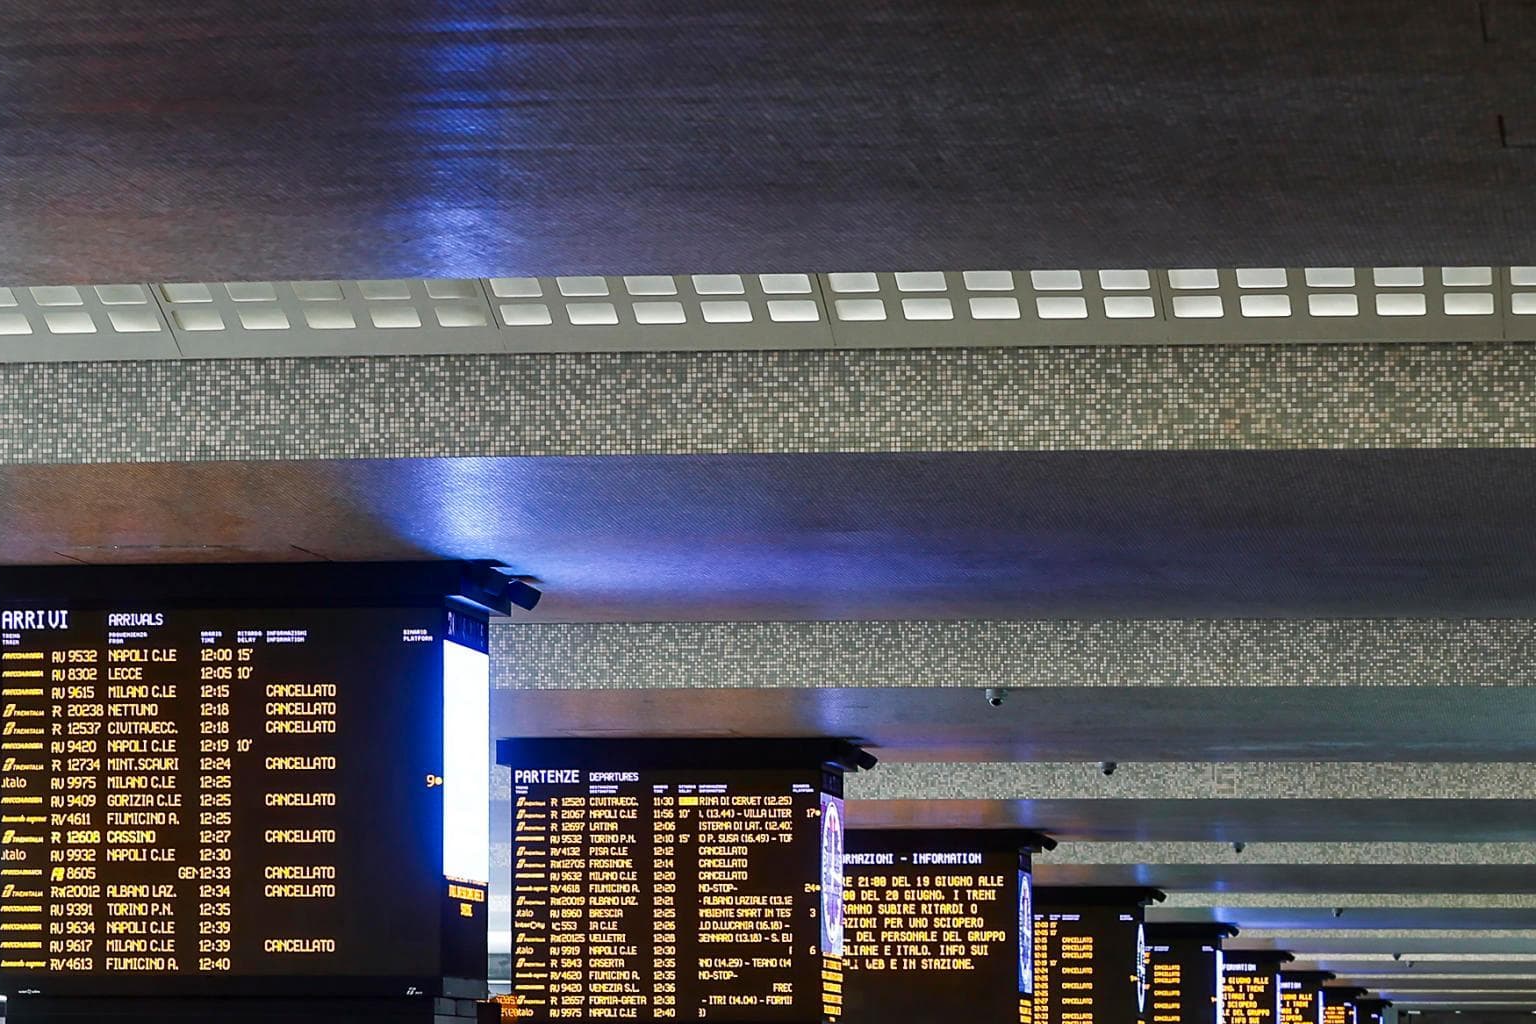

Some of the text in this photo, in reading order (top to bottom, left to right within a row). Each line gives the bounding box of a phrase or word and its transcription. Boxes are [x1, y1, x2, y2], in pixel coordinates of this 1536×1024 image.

[2, 610, 67, 629] ARRIVI
[109, 613, 163, 626] ARRIVALS
[109, 649, 232, 661] NAPOLI C.LE 12:00
[109, 667, 232, 680] LECCE 12:05
[68, 684, 336, 698] 9615 MILANO C.LE CANCELLATO
[68, 703, 336, 716] 20238 NETTUNO CANCELLATO
[108, 722, 178, 734] CIVITAVECC.
[108, 758, 178, 770] MINT.SCAURI
[515, 770, 579, 784] PARTENZE
[589, 772, 639, 781] DEPARTURES
[107, 794, 153, 806] GORIZIA
[590, 822, 618, 831] LATINA
[107, 831, 155, 843] CASSINO
[699, 846, 747, 855] CANCELLATO
[913, 853, 981, 864] INFORMATION
[858, 876, 1003, 887] 21:00 DEL 19 GIUGNO ALLE
[861, 890, 996, 901] DEL 20 GIUGNO. TRENI
[107, 903, 173, 915] TORINO P.N.
[878, 903, 963, 914] SUBIRE RITARDI
[884, 917, 983, 928] PER UNO SCIOPERO
[856, 931, 1005, 942] DEL PERSONALE DEL GRUPPO
[897, 945, 988, 955] ITALO. INFO SUI
[589, 959, 624, 967] CASERTA
[903, 959, 974, 969] IN STAZIONE.
